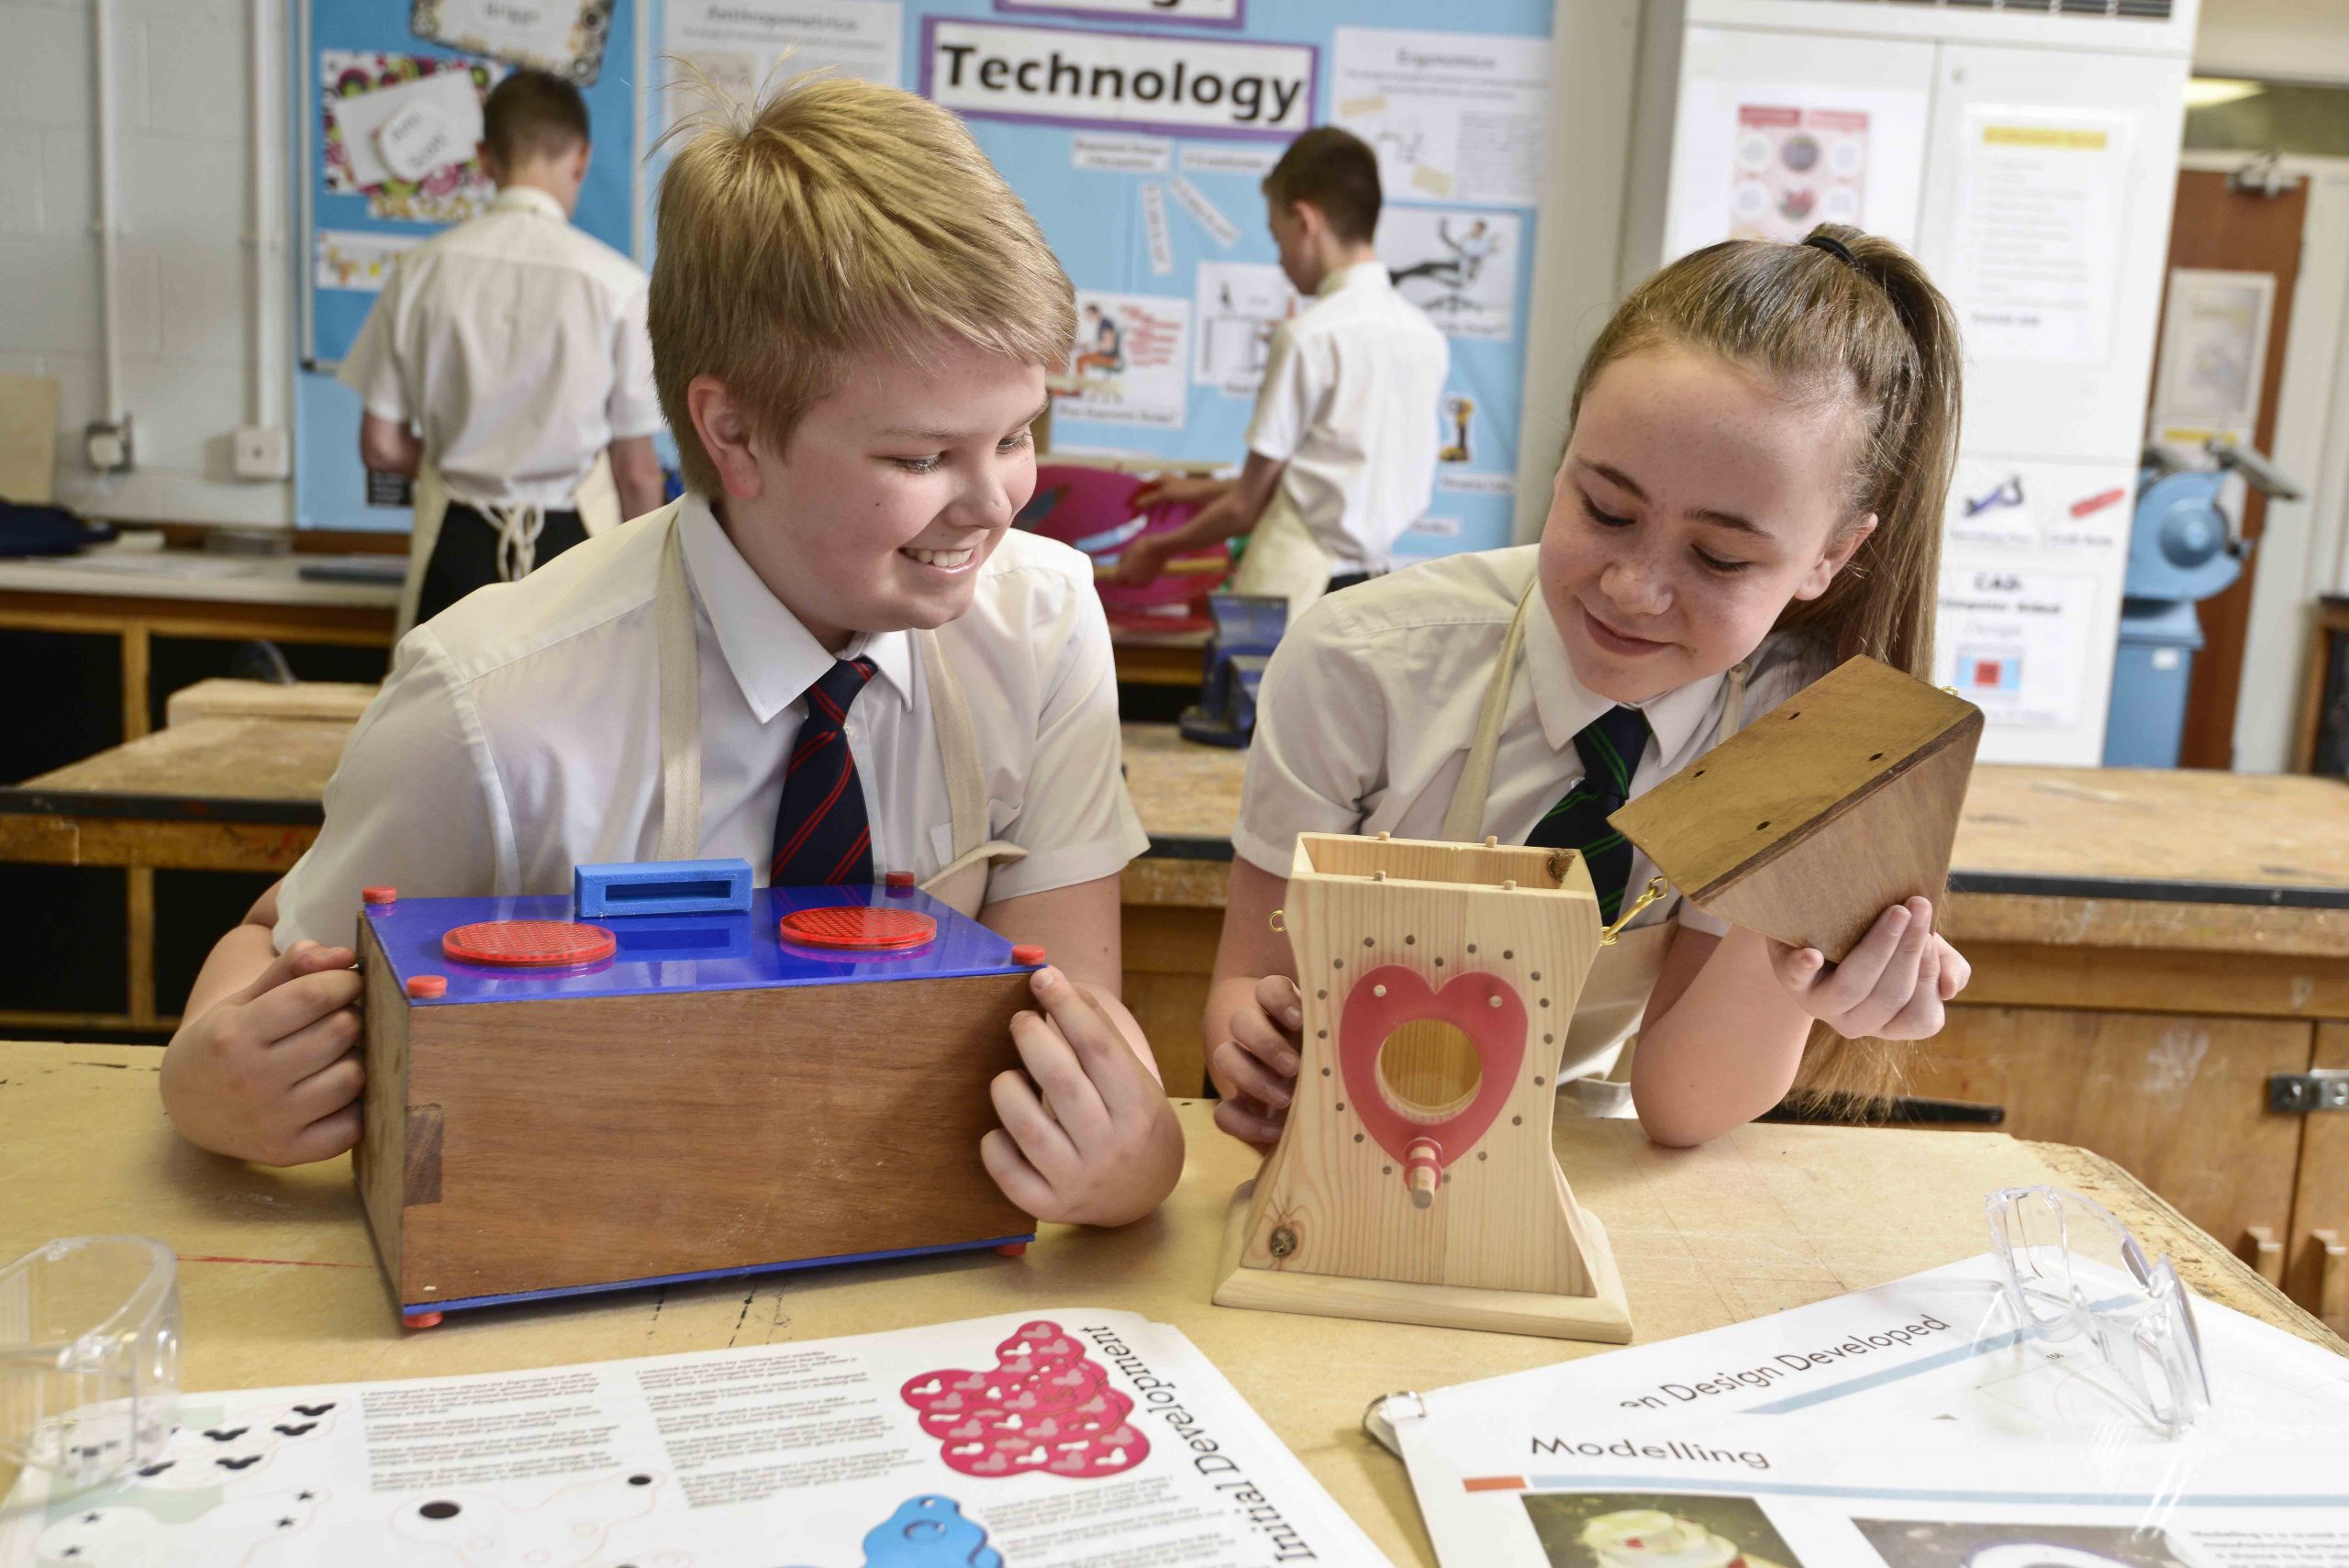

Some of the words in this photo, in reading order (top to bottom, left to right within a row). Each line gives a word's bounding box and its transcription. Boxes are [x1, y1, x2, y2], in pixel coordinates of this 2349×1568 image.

[938, 43, 1303, 124] Technology
[1659, 1364, 1785, 1402] Design
[1774, 1313, 1953, 1372] Developed
[1082, 1325, 1241, 1475] Development
[1531, 1435, 1771, 1470] Modelling
[1214, 1480, 1318, 1562] Initial
